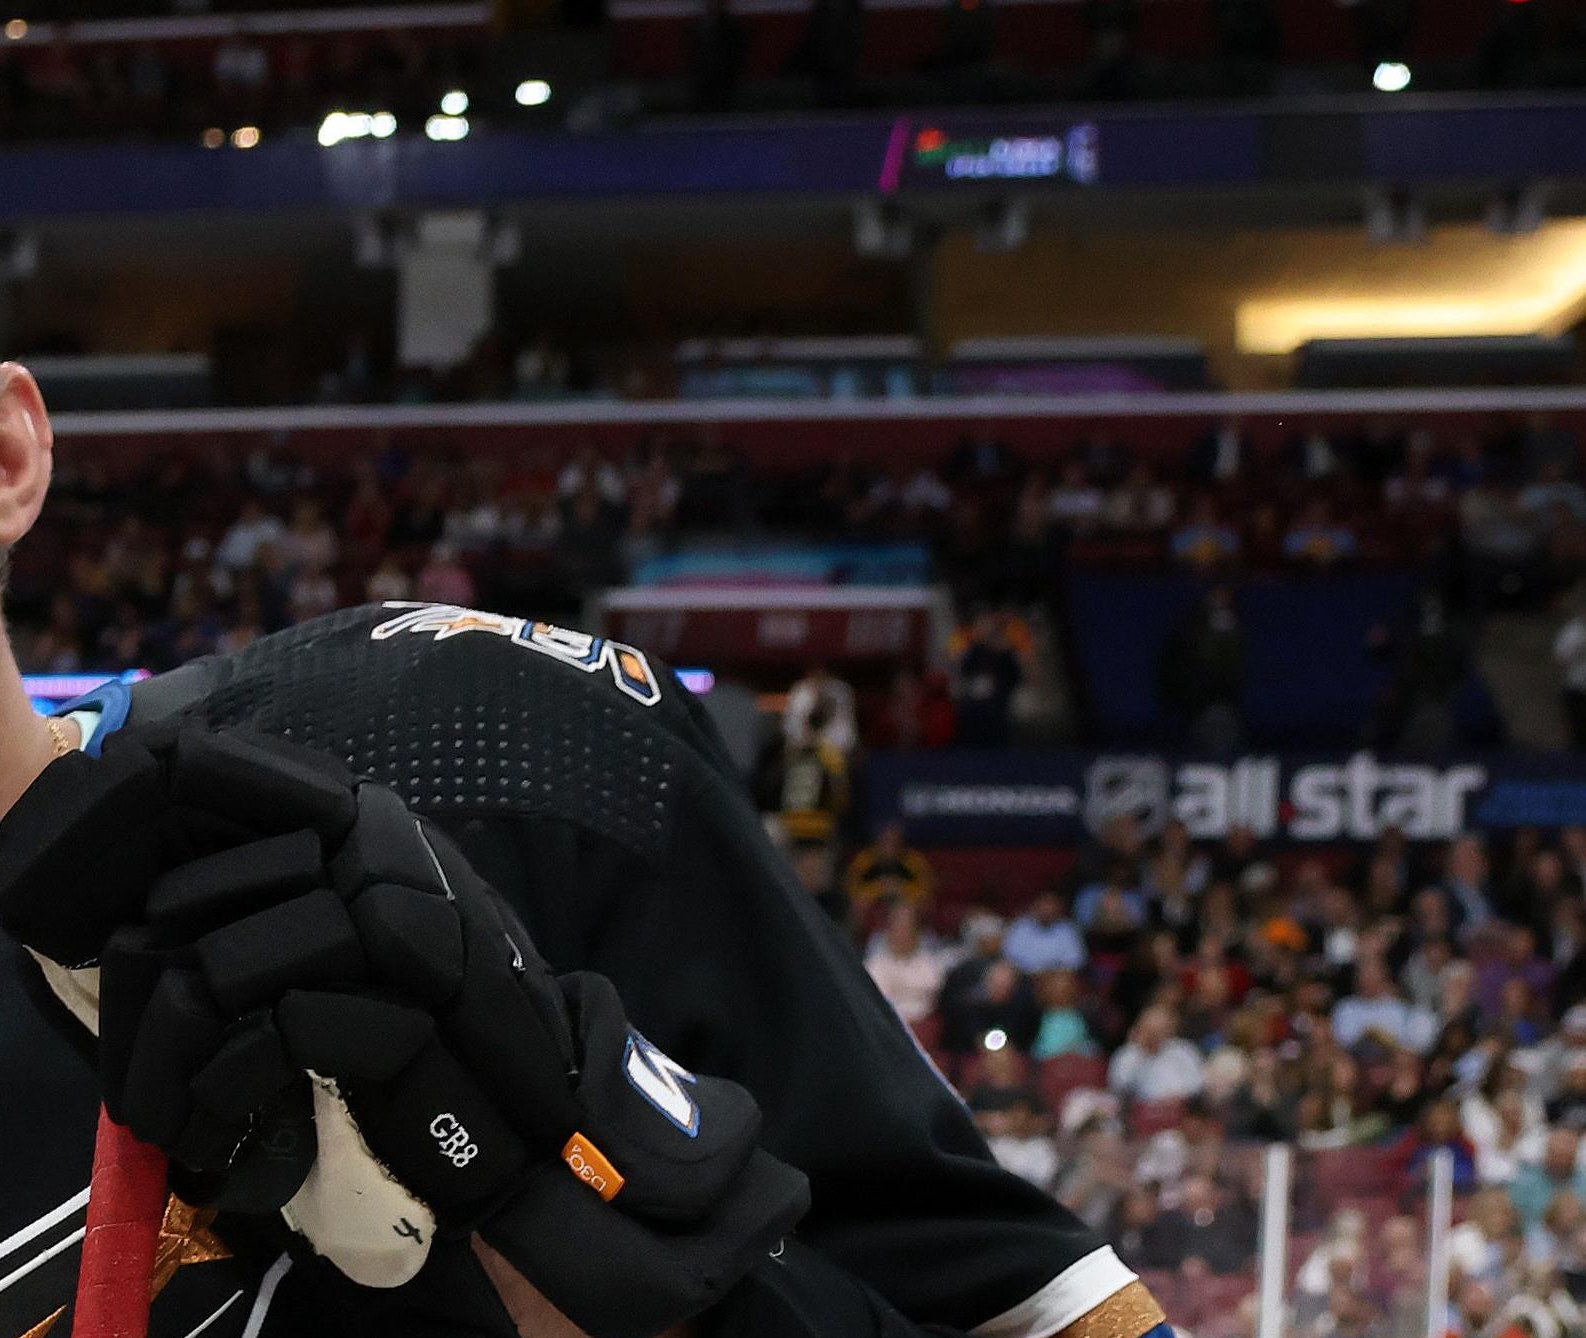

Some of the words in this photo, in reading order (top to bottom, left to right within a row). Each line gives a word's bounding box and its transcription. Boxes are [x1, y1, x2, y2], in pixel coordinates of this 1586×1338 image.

[1175, 755, 1282, 840] all
[1288, 748, 1488, 840] star
[429, 1112, 479, 1168] GR8
